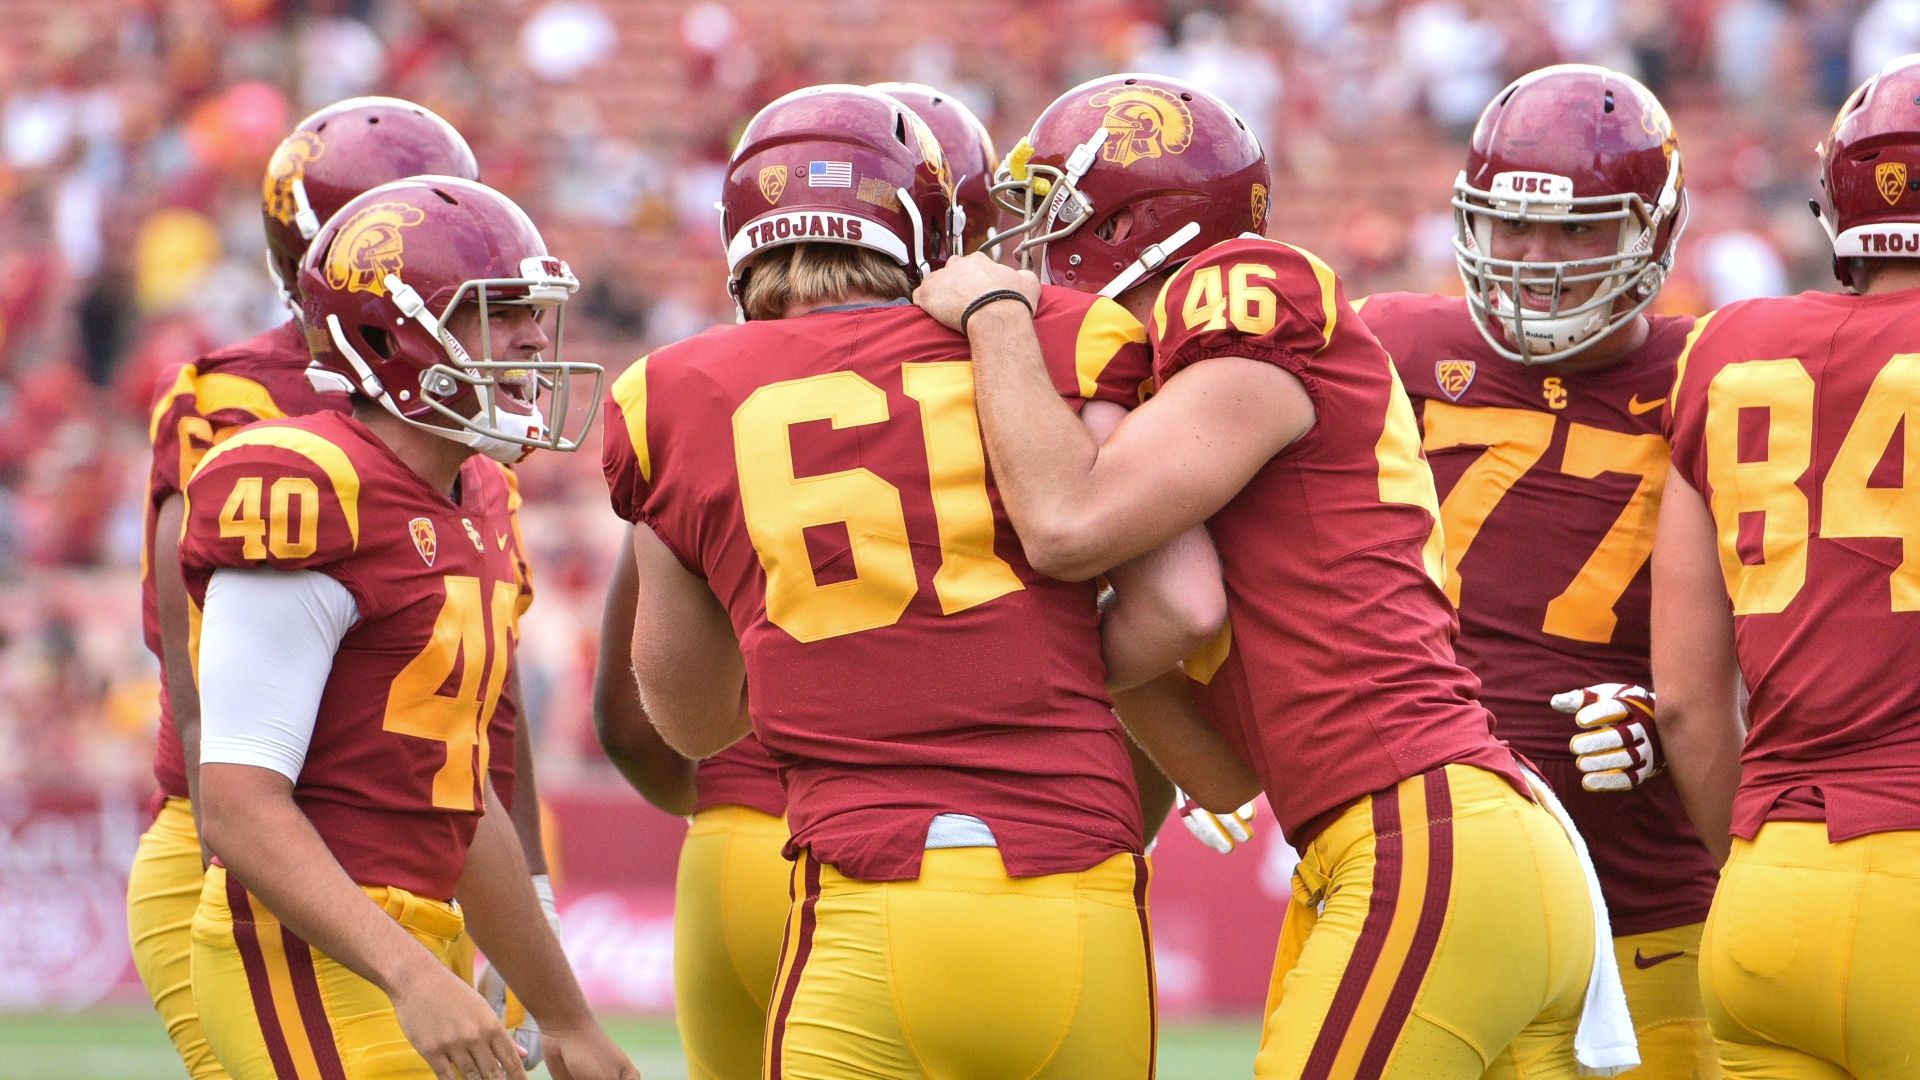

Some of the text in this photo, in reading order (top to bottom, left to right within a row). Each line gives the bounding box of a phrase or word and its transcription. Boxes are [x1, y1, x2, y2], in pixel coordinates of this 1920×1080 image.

[766, 181, 780, 197] 12
[1512, 176, 1552, 195] USC
[1884, 180, 1899, 196] 12
[747, 215, 863, 249] TROJANS
[1859, 233, 1920, 252] TROJ
[1182, 263, 1277, 335] 46
[1445, 375, 1463, 392] 12
[1706, 353, 1920, 615] 84
[219, 476, 319, 560] 40
[732, 360, 1026, 643] 61
[1423, 399, 1671, 643] 77
